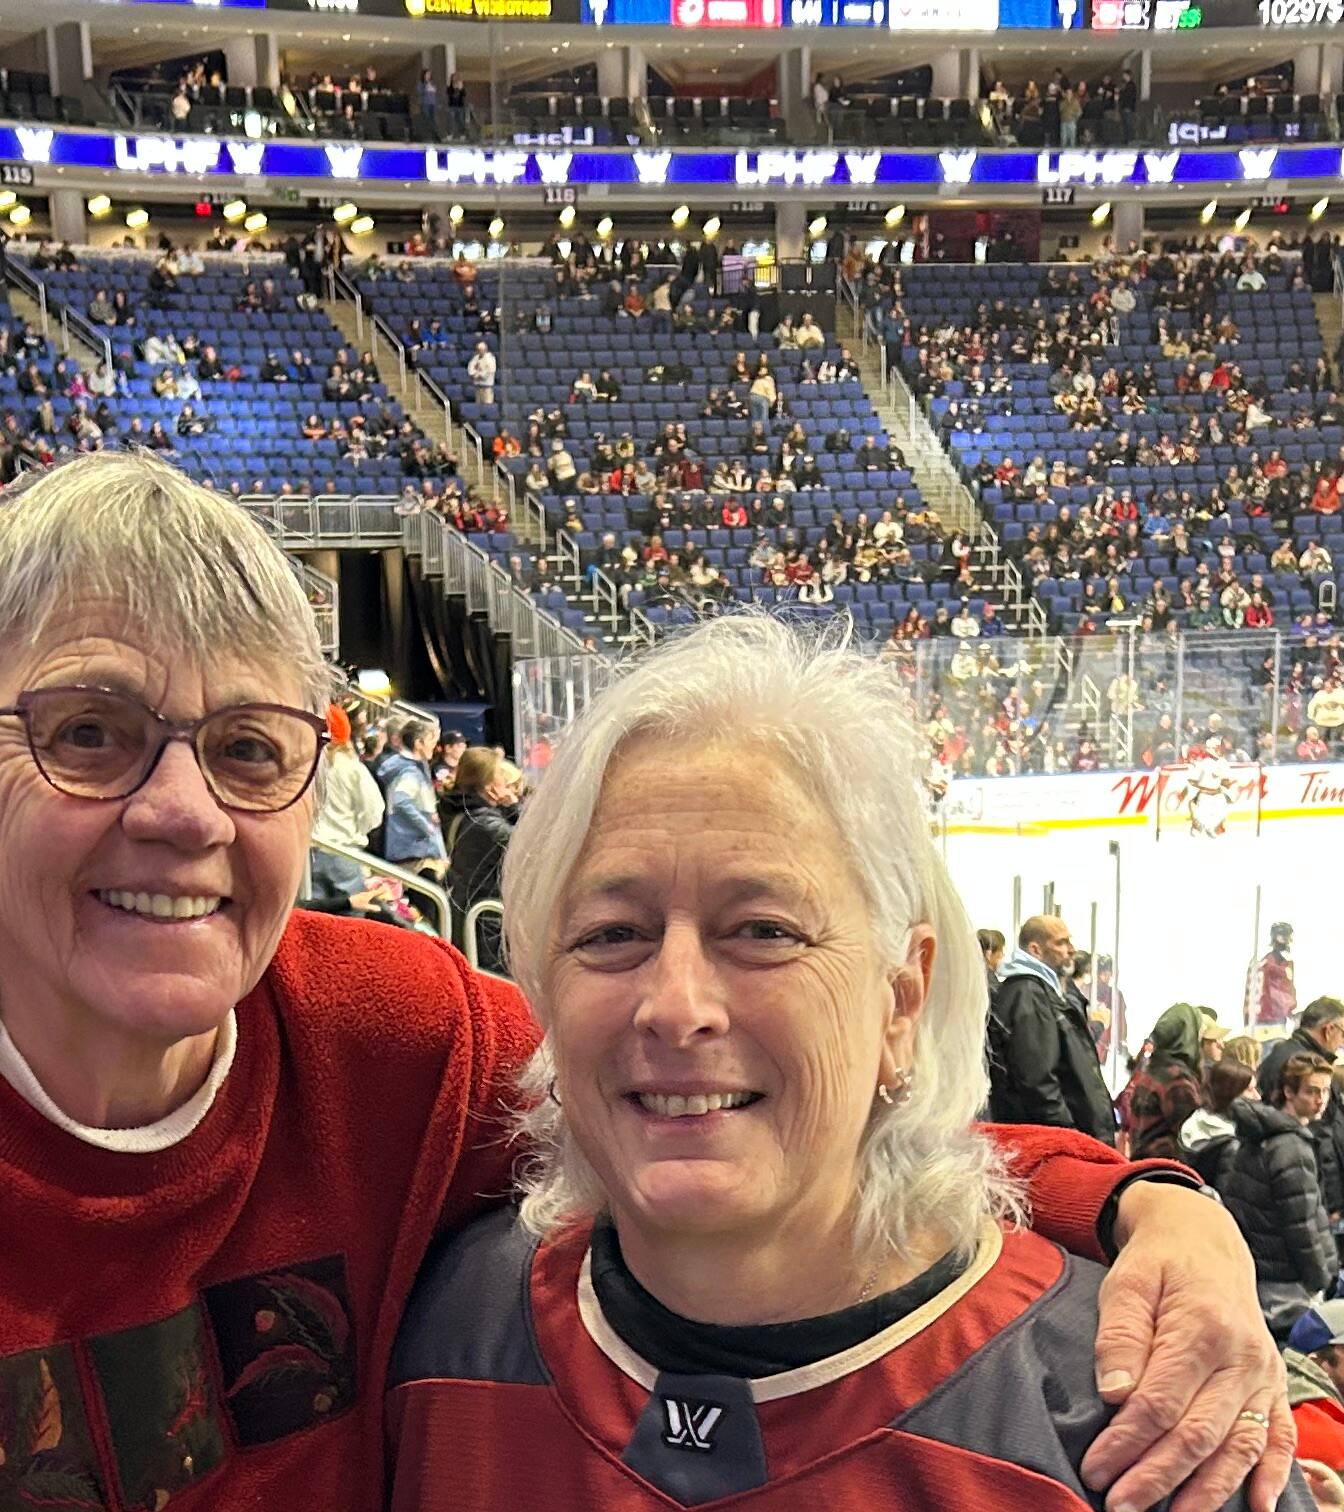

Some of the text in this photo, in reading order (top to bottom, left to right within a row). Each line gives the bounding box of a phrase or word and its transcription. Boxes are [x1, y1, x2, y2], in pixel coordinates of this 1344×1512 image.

[114, 134, 222, 174] LPHF
[425, 149, 528, 184] LPHF
[736, 150, 839, 184] LPHF
[1038, 150, 1138, 184] LPHF
[1, 167, 32, 185] 115
[1044, 188, 1073, 204] 117
